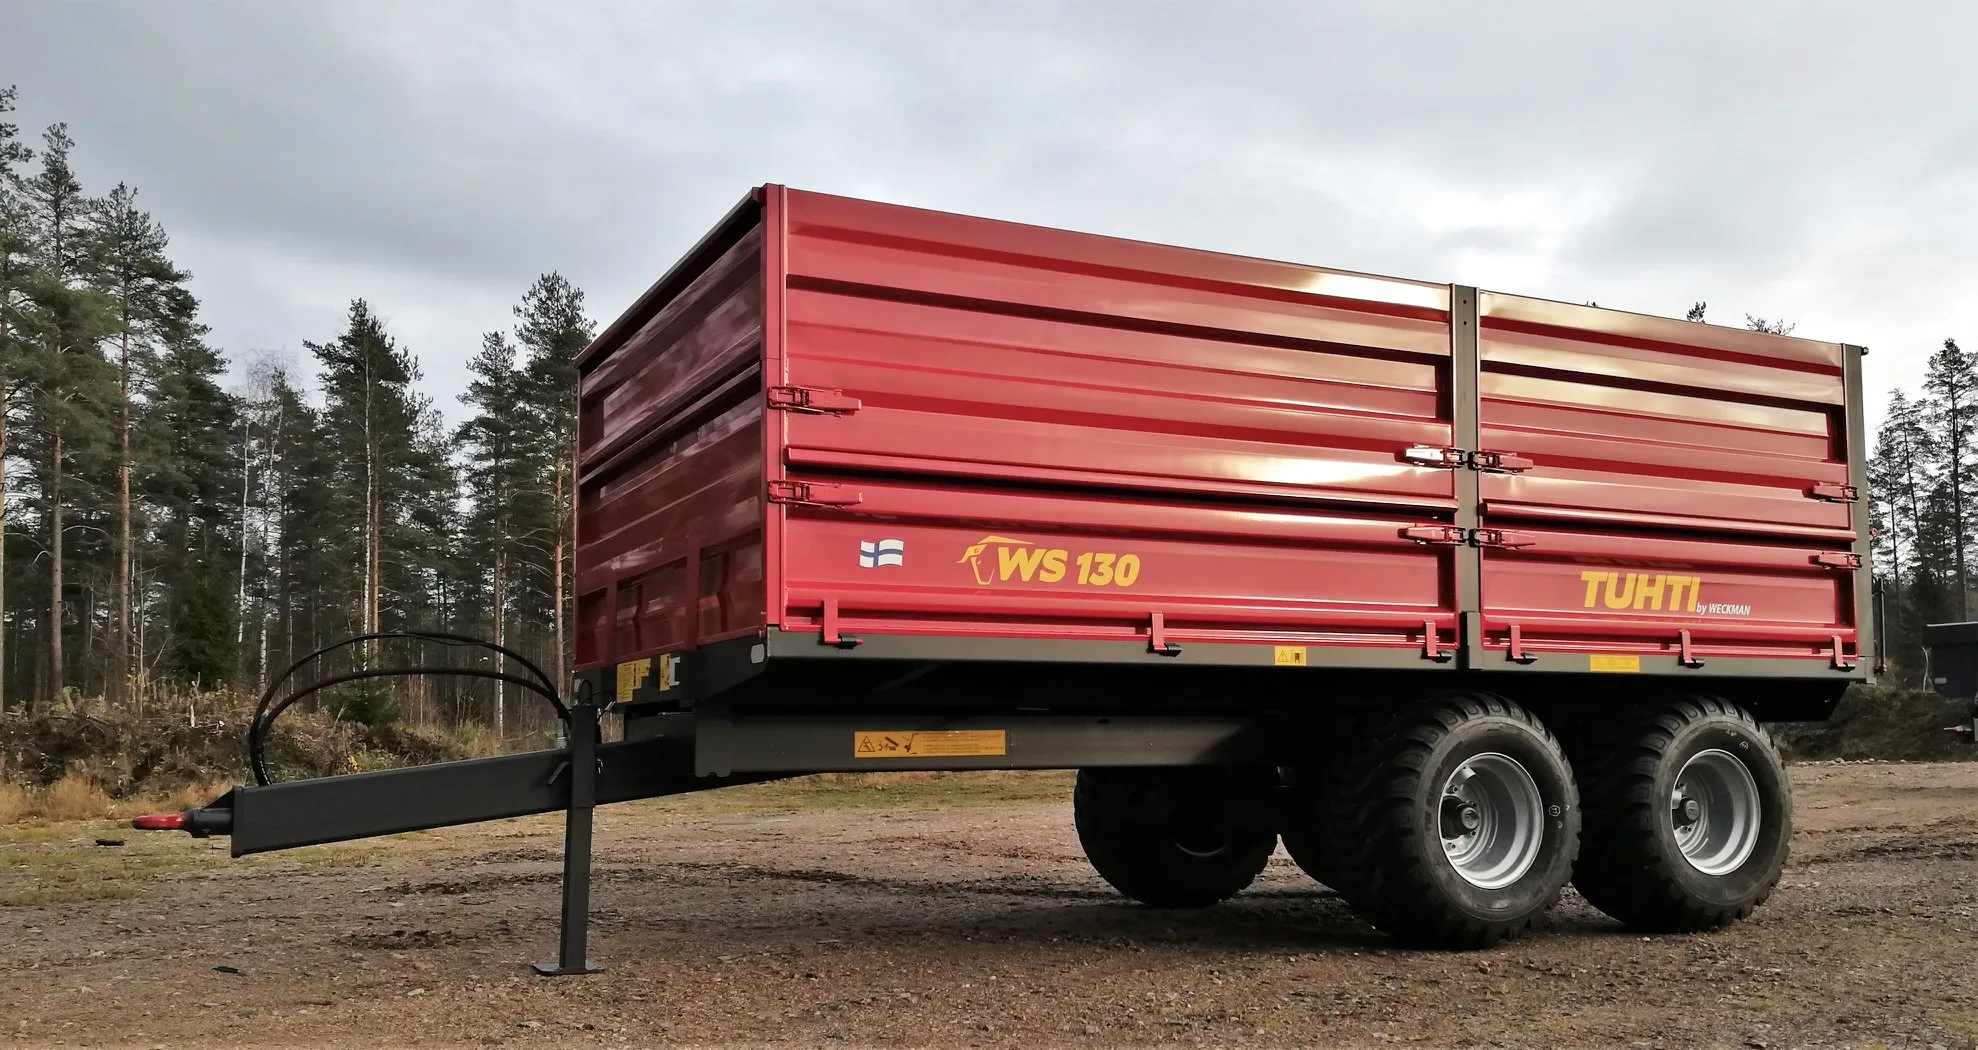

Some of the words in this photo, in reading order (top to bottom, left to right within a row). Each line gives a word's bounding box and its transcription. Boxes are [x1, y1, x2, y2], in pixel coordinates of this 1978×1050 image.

[997, 546, 1068, 583] WS
[1076, 552, 1141, 587] 130
[1580, 570, 1701, 613] TUHTI
[1696, 602, 1707, 616] by
[1708, 603, 1751, 616] WECKMAN
